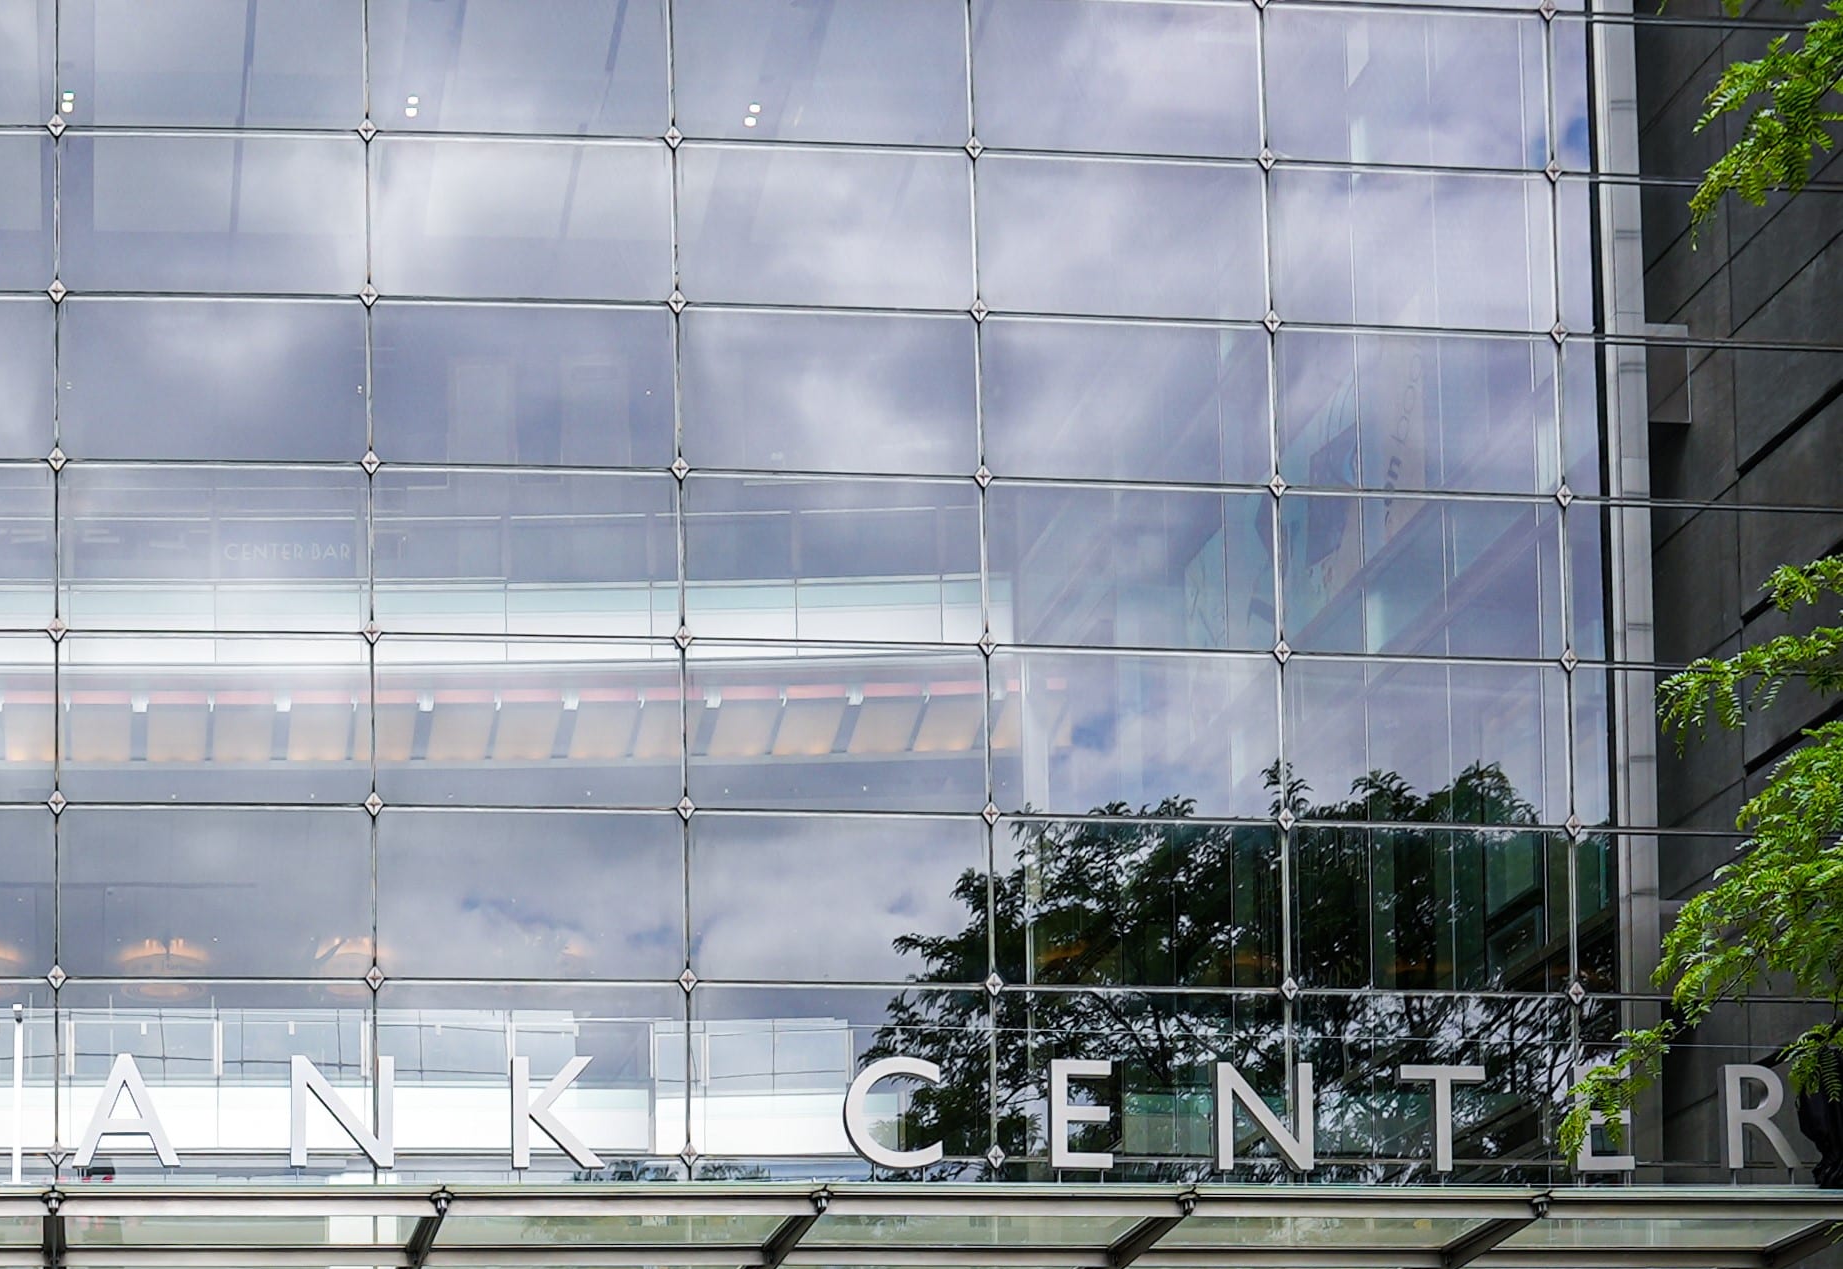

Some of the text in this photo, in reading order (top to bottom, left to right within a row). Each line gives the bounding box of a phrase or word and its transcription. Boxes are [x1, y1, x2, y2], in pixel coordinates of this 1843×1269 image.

[224, 543, 350, 560] CENTER BAR
[843, 1057, 1801, 1172] CENTER
